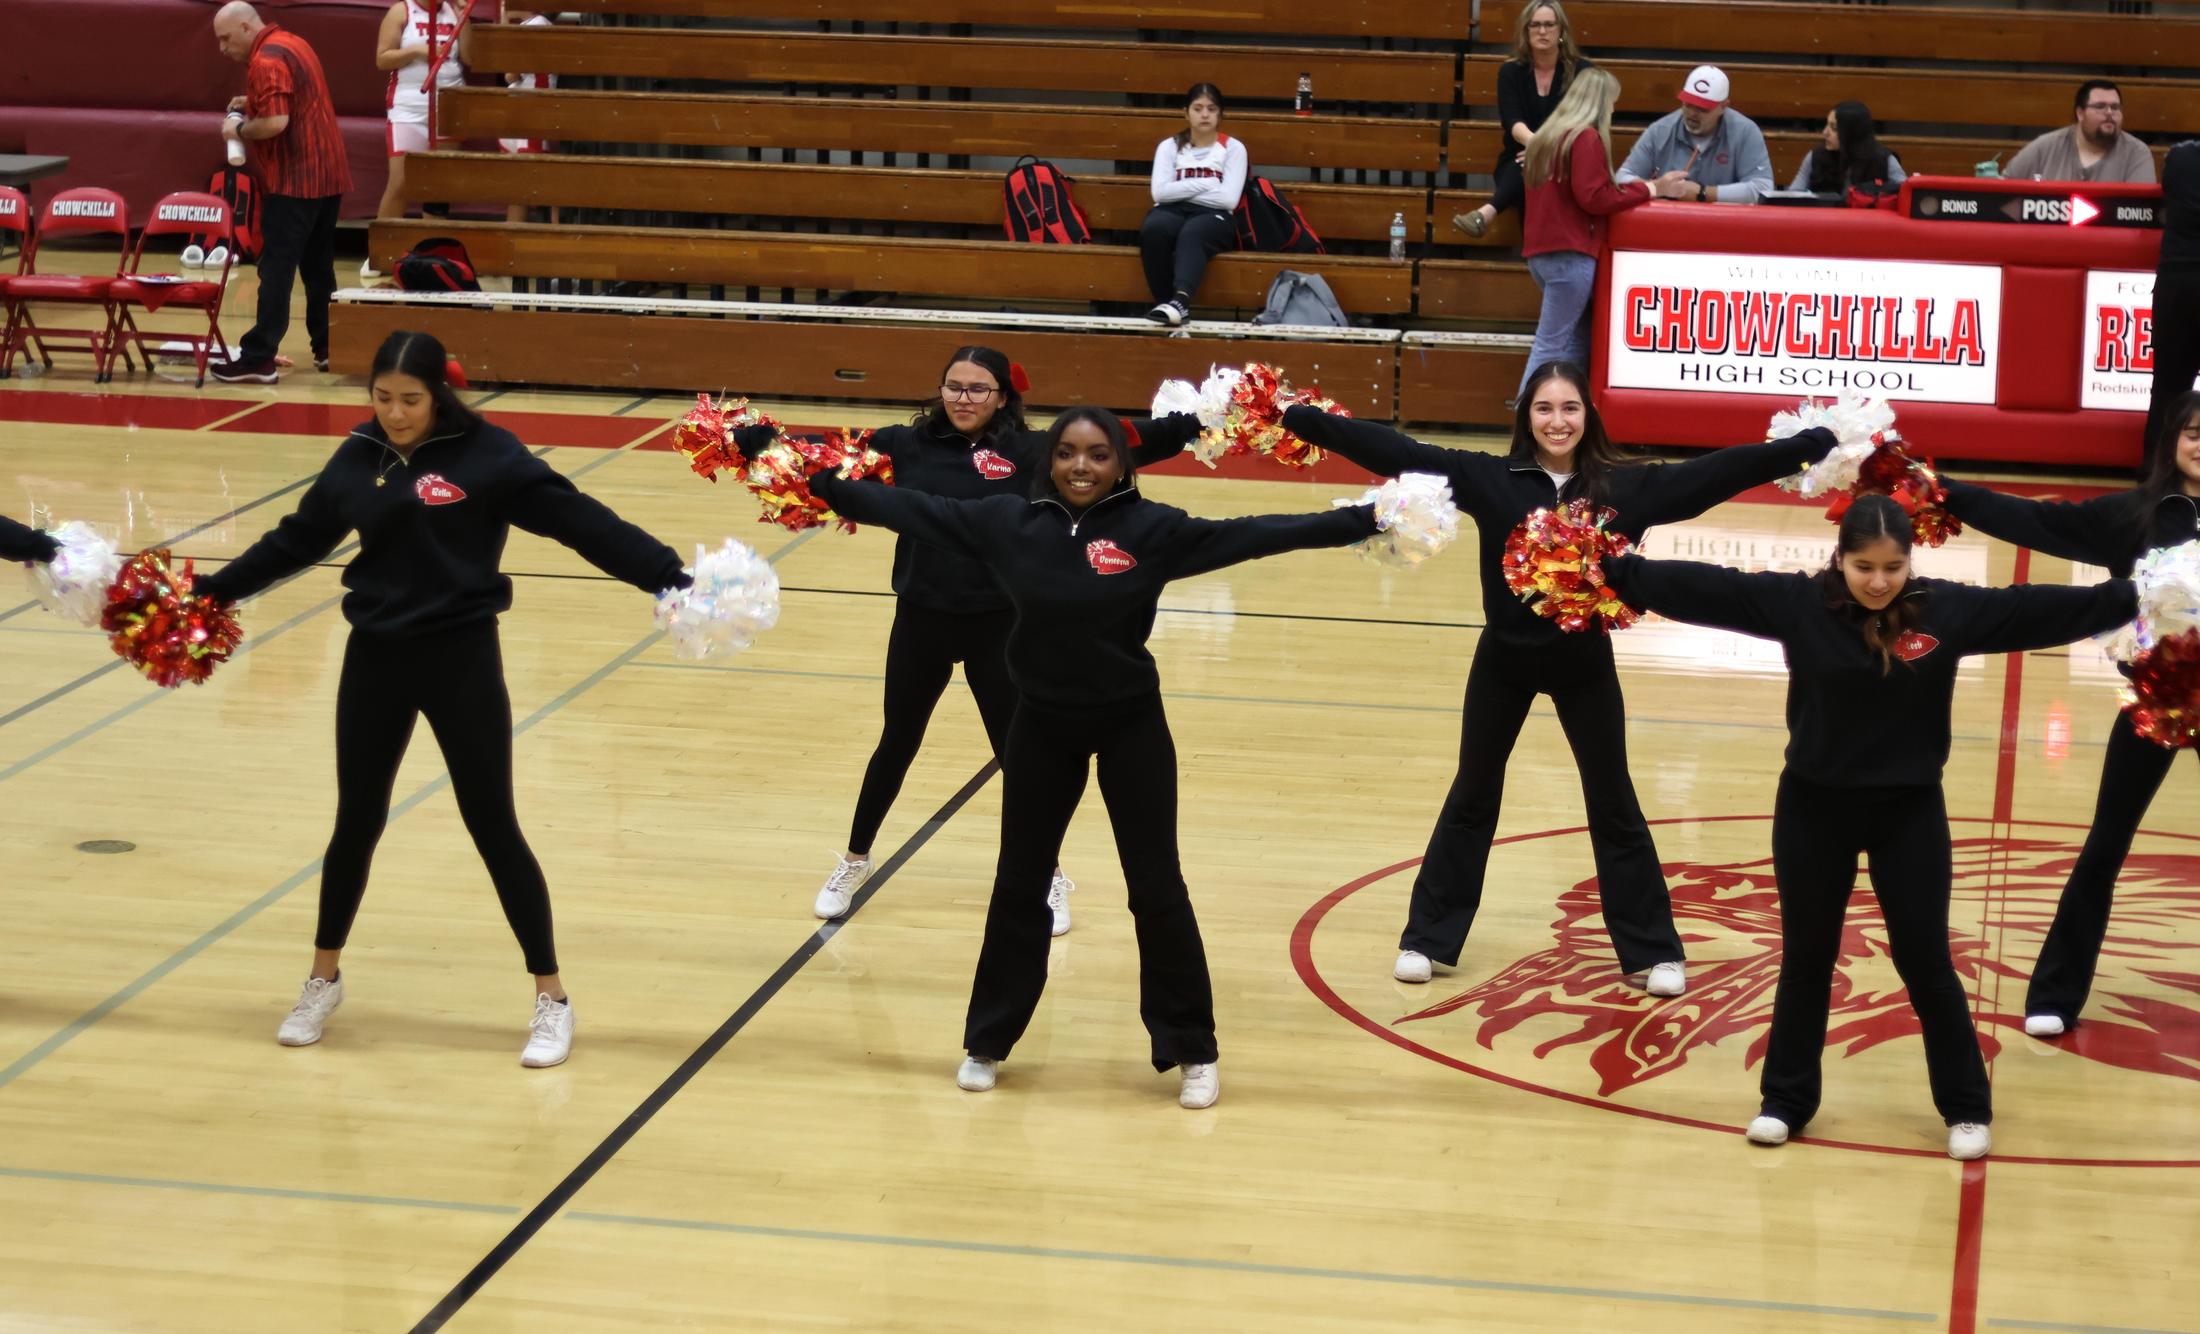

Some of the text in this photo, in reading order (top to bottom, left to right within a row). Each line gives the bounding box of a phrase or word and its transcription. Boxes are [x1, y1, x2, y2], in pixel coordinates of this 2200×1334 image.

[1694, 79, 1710, 94] C
[52, 200, 115, 217] CHOWCHILLA
[158, 204, 222, 223] CHOWCHILLA
[1941, 199, 1978, 214] BONUS
[2022, 198, 2072, 223] POSS
[2116, 205, 2154, 222] BONUS
[1623, 283, 1985, 366] CHOWCHILLA
[1680, 362, 1925, 391] HIGH SCHOOL
